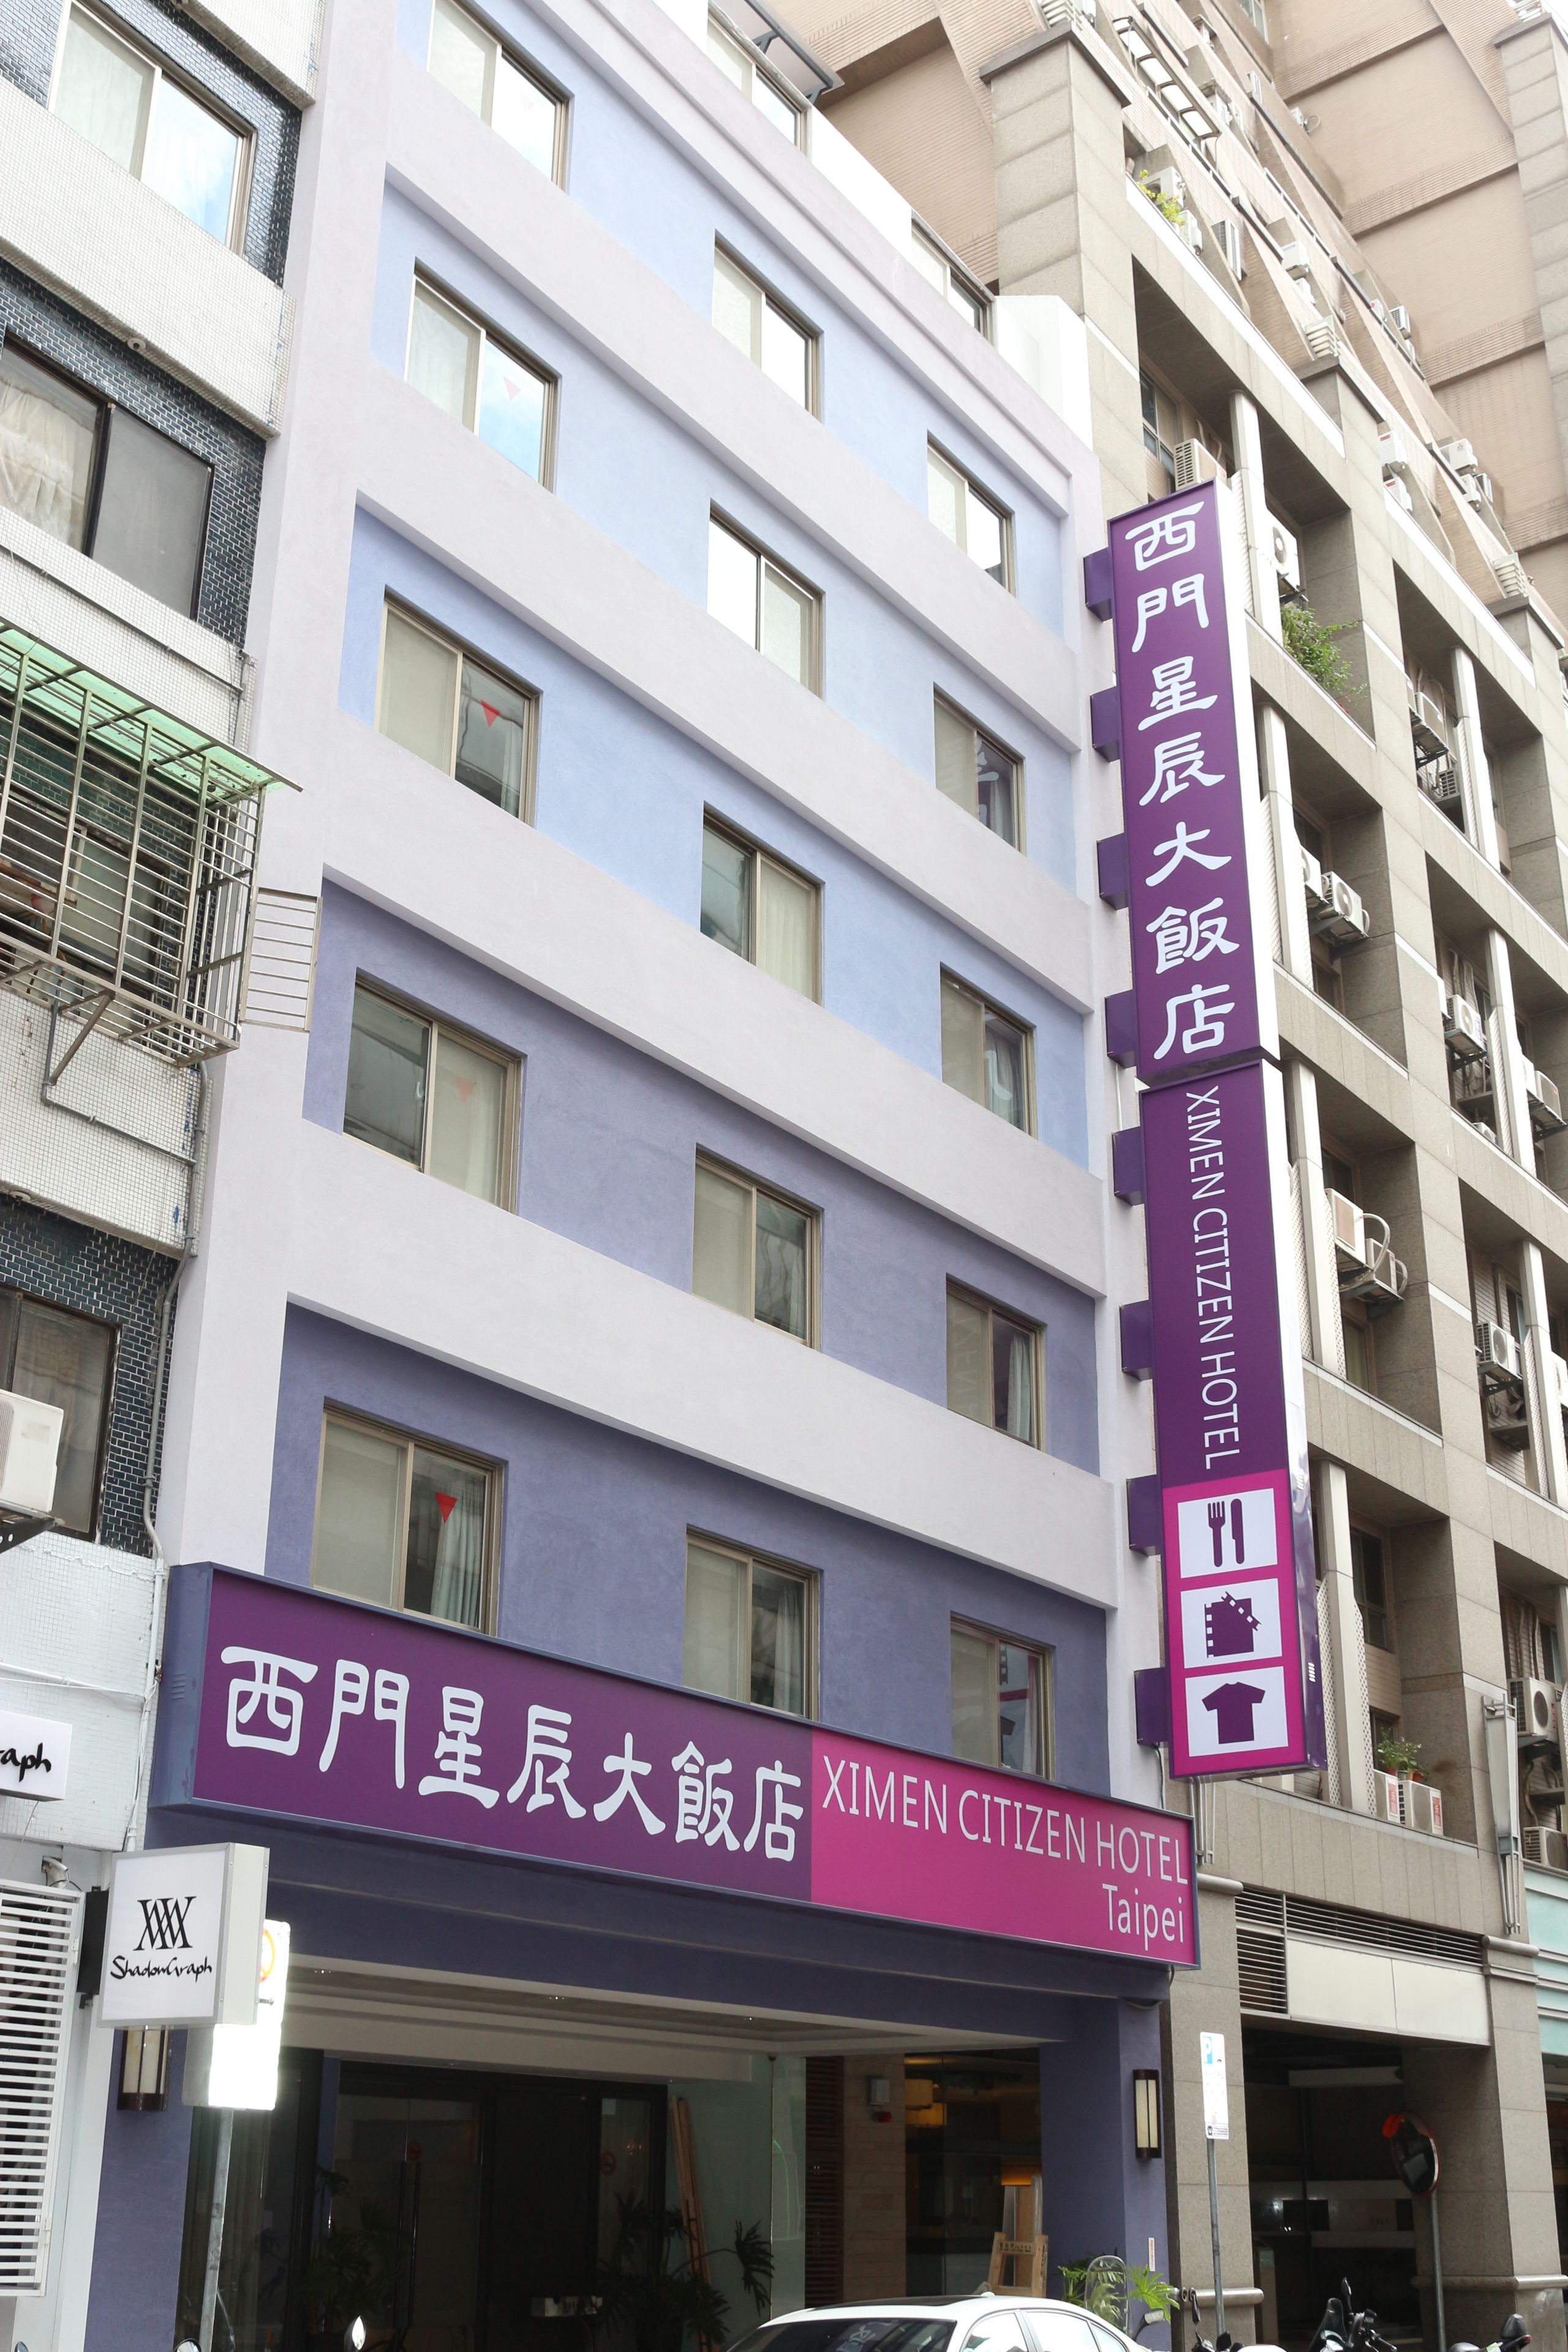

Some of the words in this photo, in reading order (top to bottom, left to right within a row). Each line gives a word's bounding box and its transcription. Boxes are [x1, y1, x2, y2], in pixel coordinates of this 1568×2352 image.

[1125, 499, 1240, 1060] 西門星辰大飯店
[1186, 1085, 1226, 1200] XIMEN
[1193, 1208, 1234, 1343] CITIZEN
[1200, 1351, 1240, 1470] HOTEL
[221, 1645, 804, 1862] 西門星辰大飯店
[822, 1755, 948, 1834] XIMEN
[958, 1789, 1085, 1864] CITIZEN
[1096, 1820, 1189, 1885] HOTEL
[110, 1955, 213, 1983] ShadowGraph
[1102, 1883, 1185, 1951] Taipei
